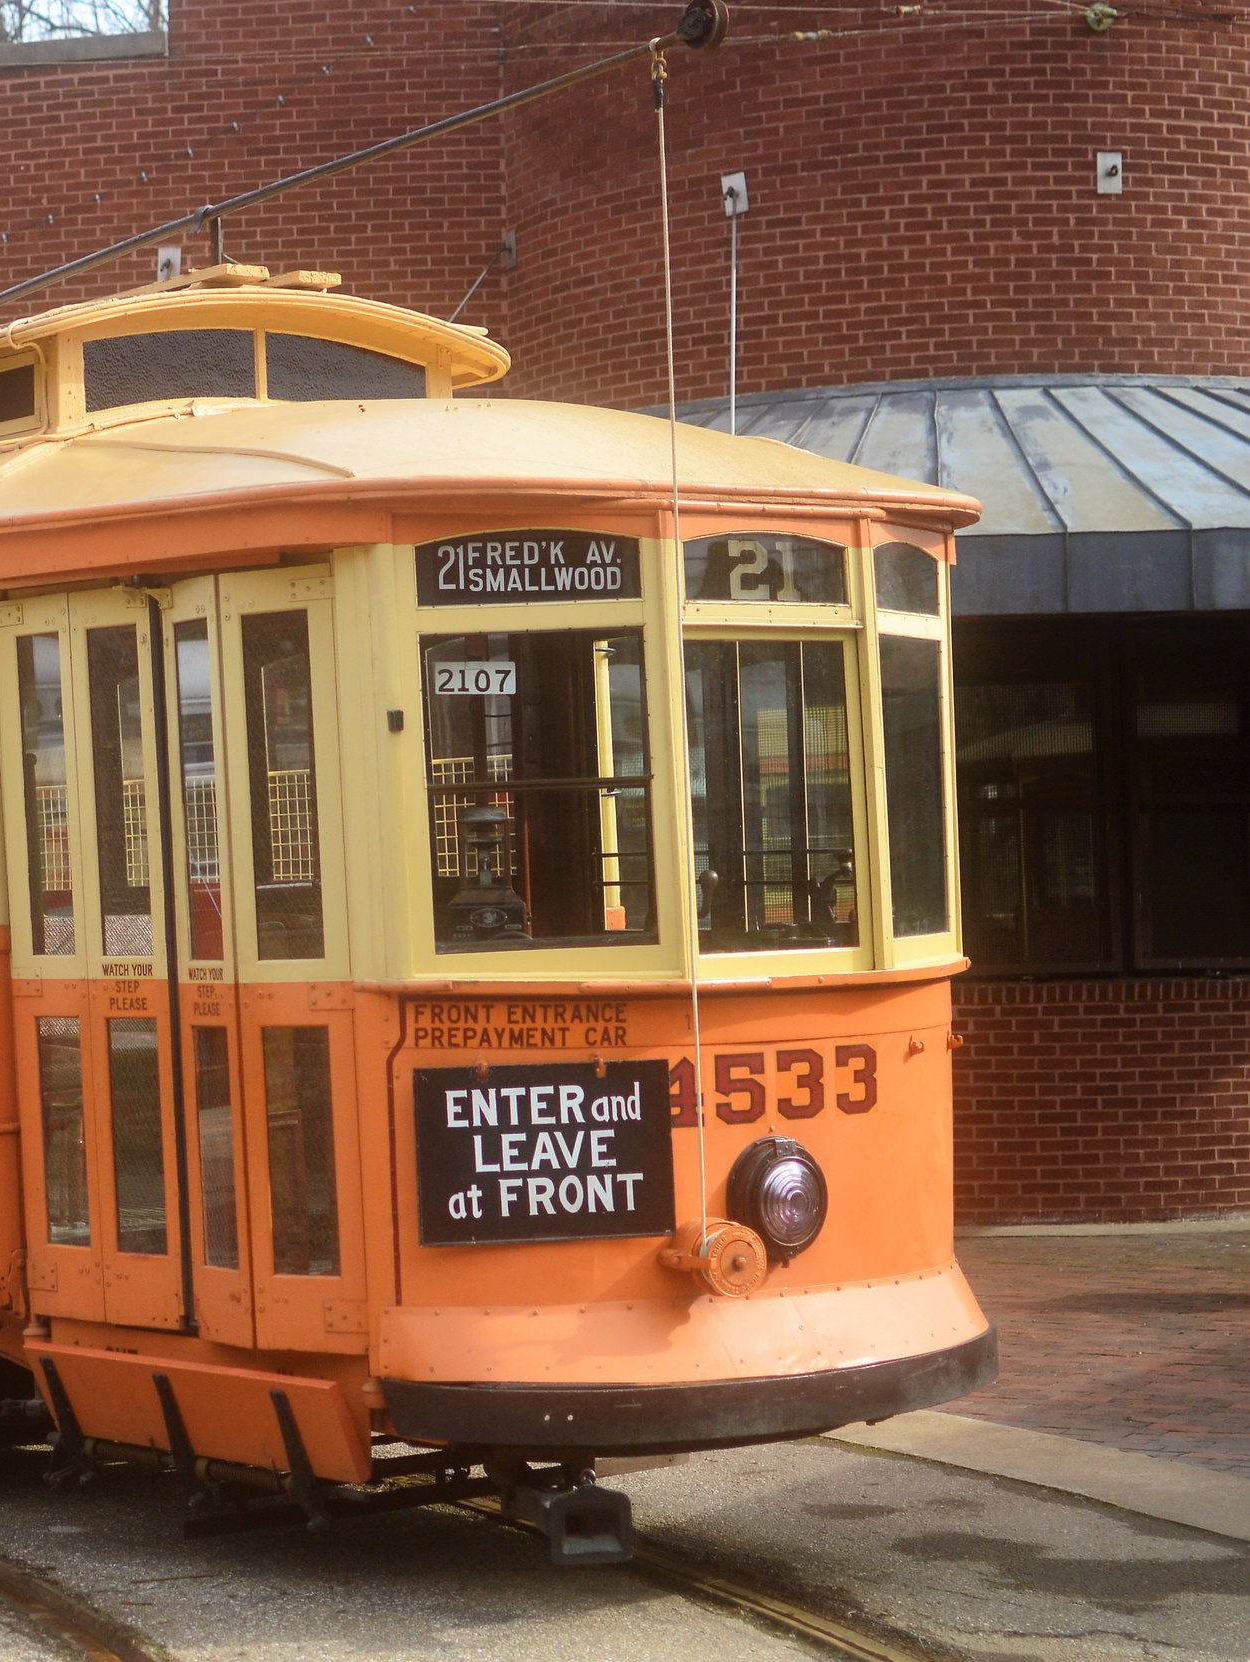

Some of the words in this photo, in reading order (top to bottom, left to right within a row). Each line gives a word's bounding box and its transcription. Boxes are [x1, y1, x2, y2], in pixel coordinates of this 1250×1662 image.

[467, 541, 566, 566] FRED'K
[586, 540, 622, 564] AV.
[437, 544, 465, 590] 21
[468, 566, 622, 592] SMALLWOOD
[727, 539, 801, 601] 21
[437, 668, 512, 693] 2107
[101, 964, 129, 977] WATCH
[132, 964, 153, 977] YOUR
[187, 968, 208, 981] WATCH
[208, 968, 224, 981] YOUR
[115, 981, 140, 994] STEP
[197, 985, 215, 999] STEP
[110, 997, 148, 1011] PLEASE
[193, 1003, 221, 1016] PLEASE
[414, 1004, 500, 1025] FRONT
[507, 1002, 628, 1024] ENTRANCE
[414, 1026, 571, 1048] PREPAYMENT
[585, 1026, 628, 1047] CAR
[445, 1085, 584, 1129] ENTER
[590, 1081, 642, 1123] and
[473, 1129, 617, 1173] LEAVE
[448, 1184, 483, 1220] at
[499, 1172, 644, 1218] FRONT
